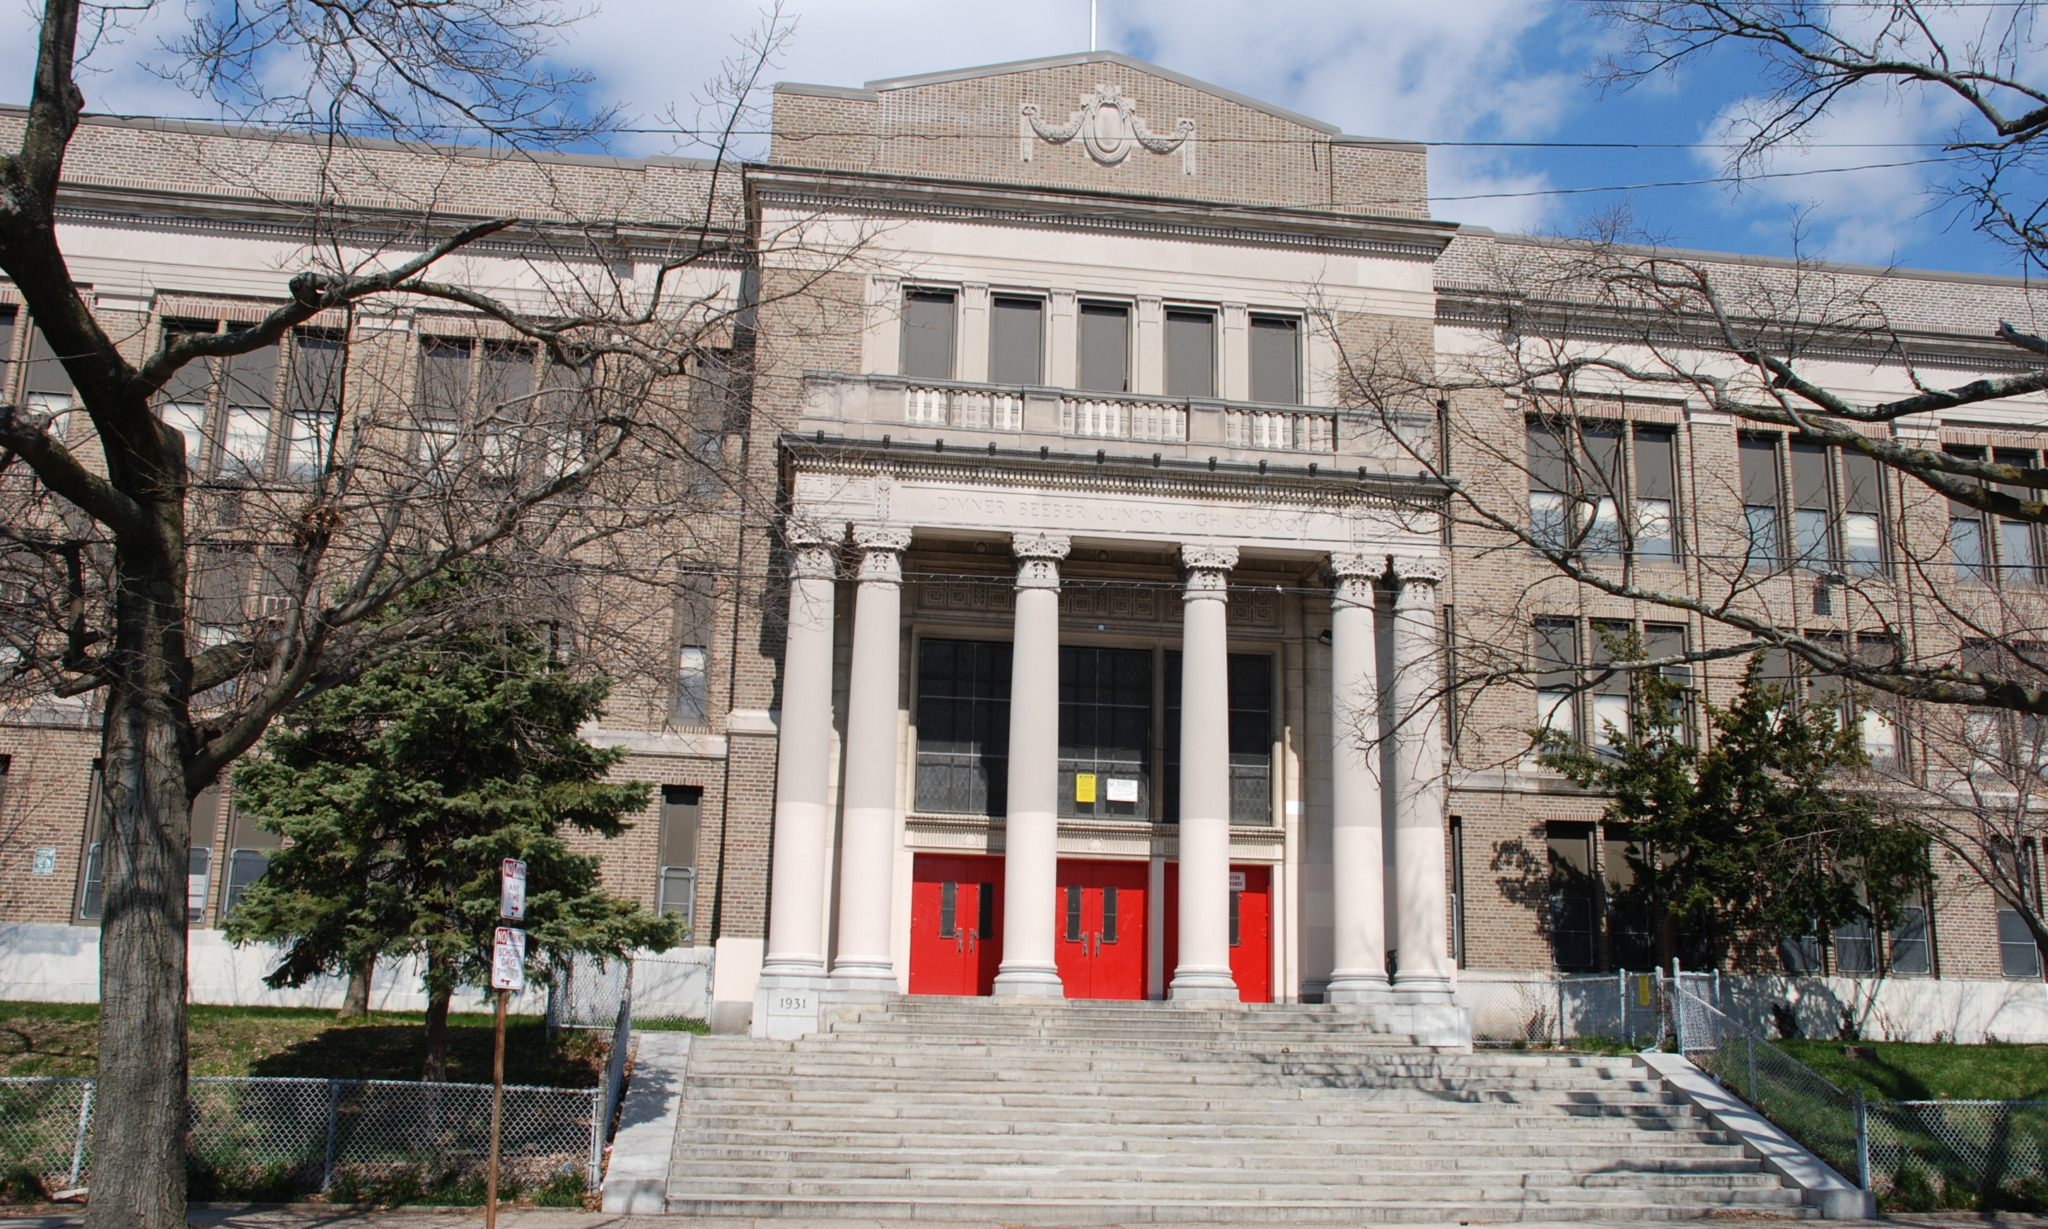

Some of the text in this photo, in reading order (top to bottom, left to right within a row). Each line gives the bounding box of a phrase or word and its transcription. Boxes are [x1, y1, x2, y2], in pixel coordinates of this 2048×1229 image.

[937, 496, 1308, 533] DIMNER BEEBER JUNIOR HIGH SCHOOL
[509, 883, 521, 892] ANY
[508, 892, 520, 902] TIME
[497, 929, 508, 944] NO
[498, 947, 521, 959] SCHOOL
[501, 957, 517, 968] DAYS
[780, 997, 806, 1009] 1931
